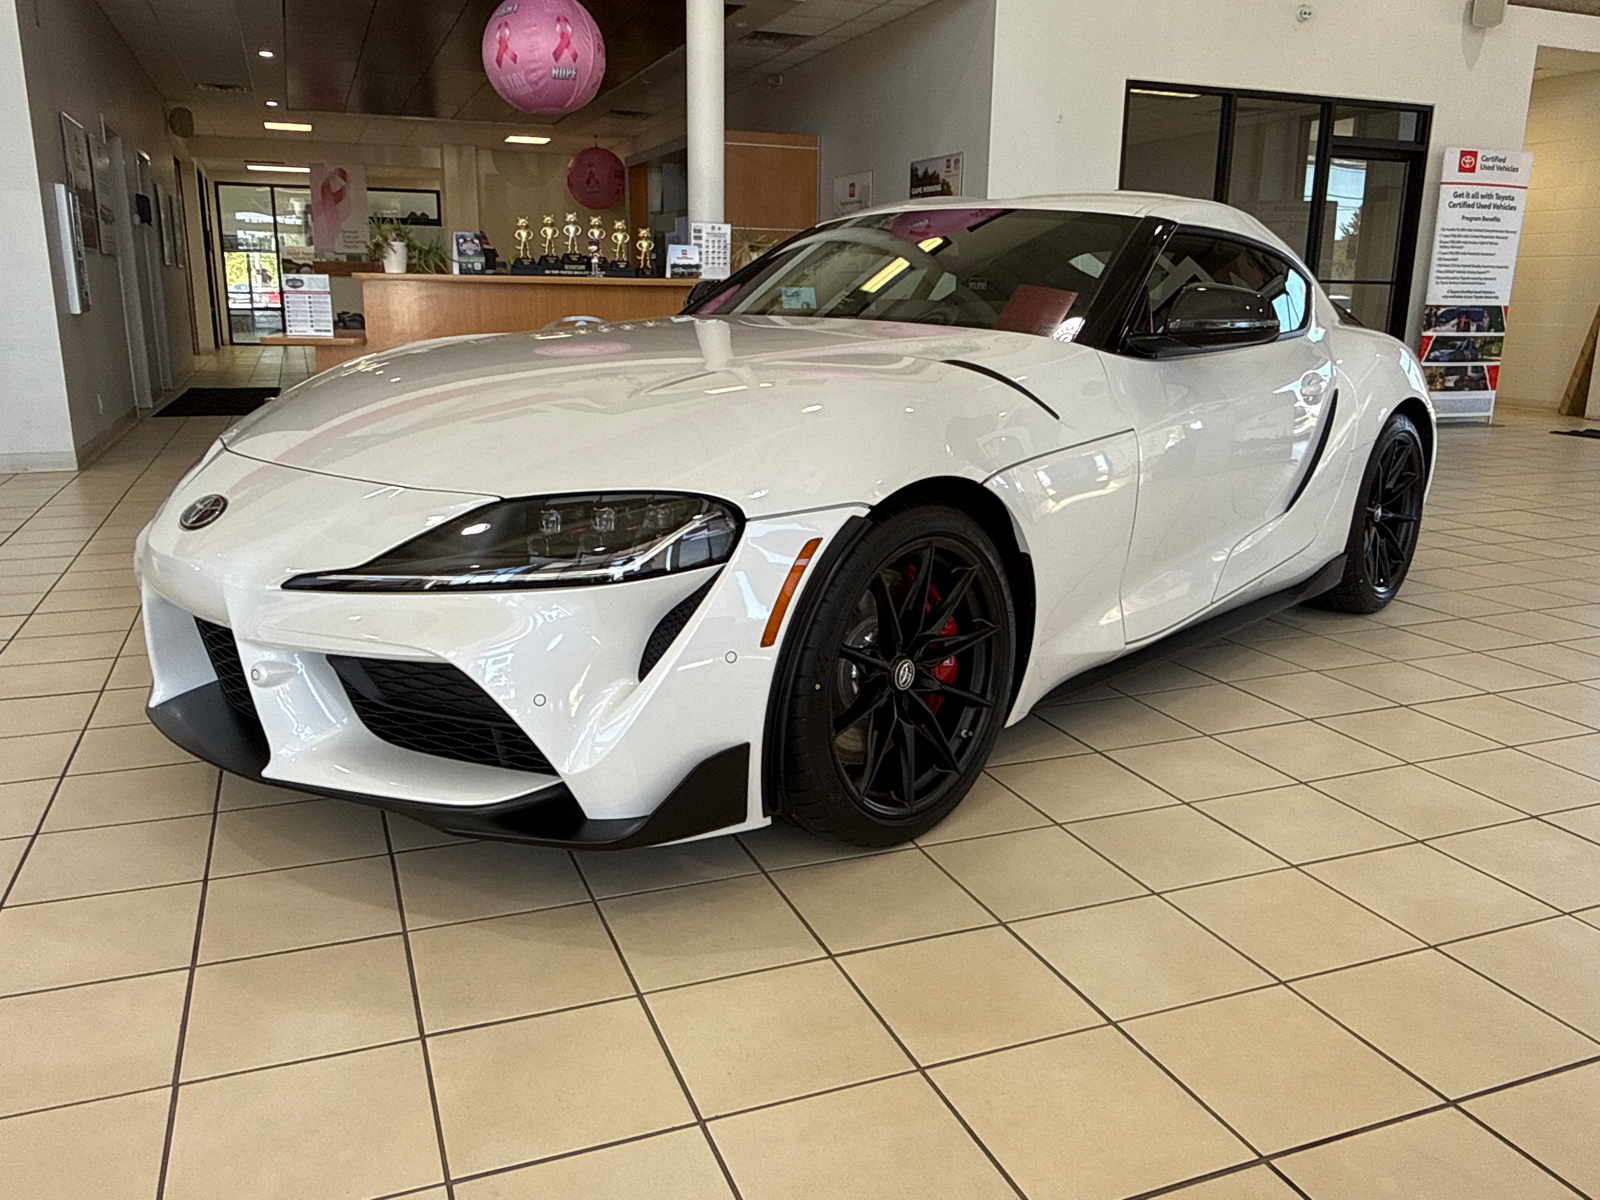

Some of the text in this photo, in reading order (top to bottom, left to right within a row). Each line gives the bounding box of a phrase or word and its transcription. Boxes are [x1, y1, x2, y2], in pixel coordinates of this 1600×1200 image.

[551, 66, 577, 80] HOPE
[1481, 155, 1507, 163] Certified
[1496, 164, 1519, 173] Vehicles
[1453, 191, 1515, 202] Get it all with Toyota
[1448, 201, 1517, 211] Certified Used Vehicles
[1461, 215, 1481, 223] Program
